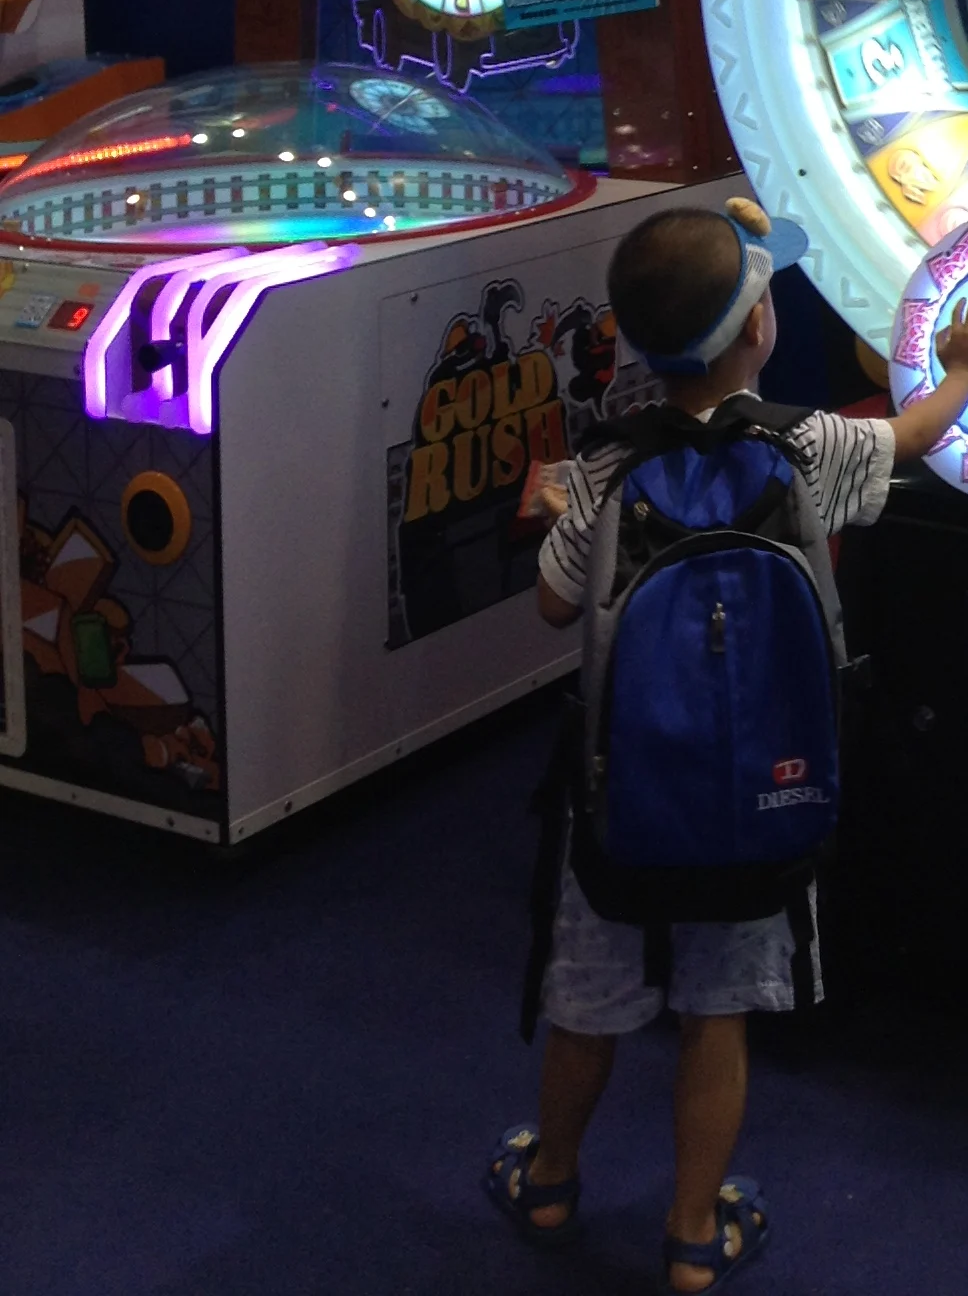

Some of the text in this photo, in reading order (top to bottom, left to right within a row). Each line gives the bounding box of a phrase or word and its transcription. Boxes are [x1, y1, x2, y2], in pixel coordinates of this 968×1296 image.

[421, 351, 554, 443] GOLD
[404, 399, 568, 522] RUSH
[757, 787, 831, 810] DIESEL
